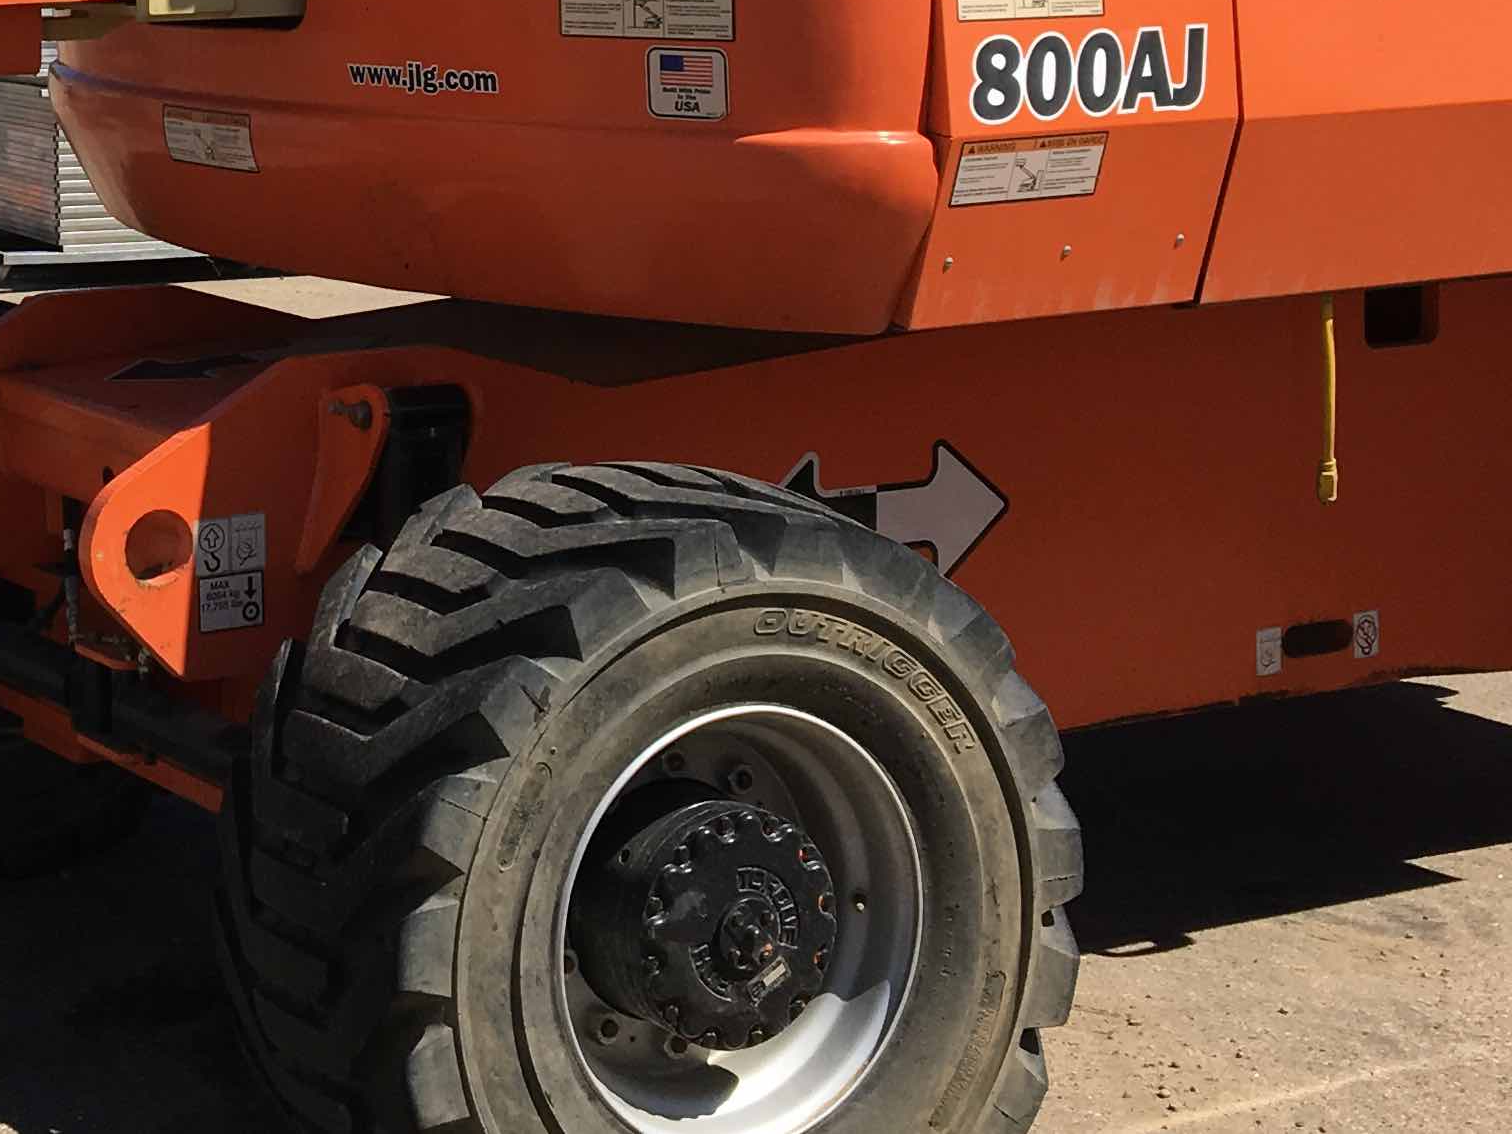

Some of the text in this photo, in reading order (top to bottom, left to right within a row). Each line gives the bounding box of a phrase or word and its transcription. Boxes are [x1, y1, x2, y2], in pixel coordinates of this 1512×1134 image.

[349, 62, 498, 94] www.jlg.com
[674, 101, 700, 113] USA
[970, 24, 1208, 124] 800AJ
[754, 607, 978, 755] OUTRIGGER
